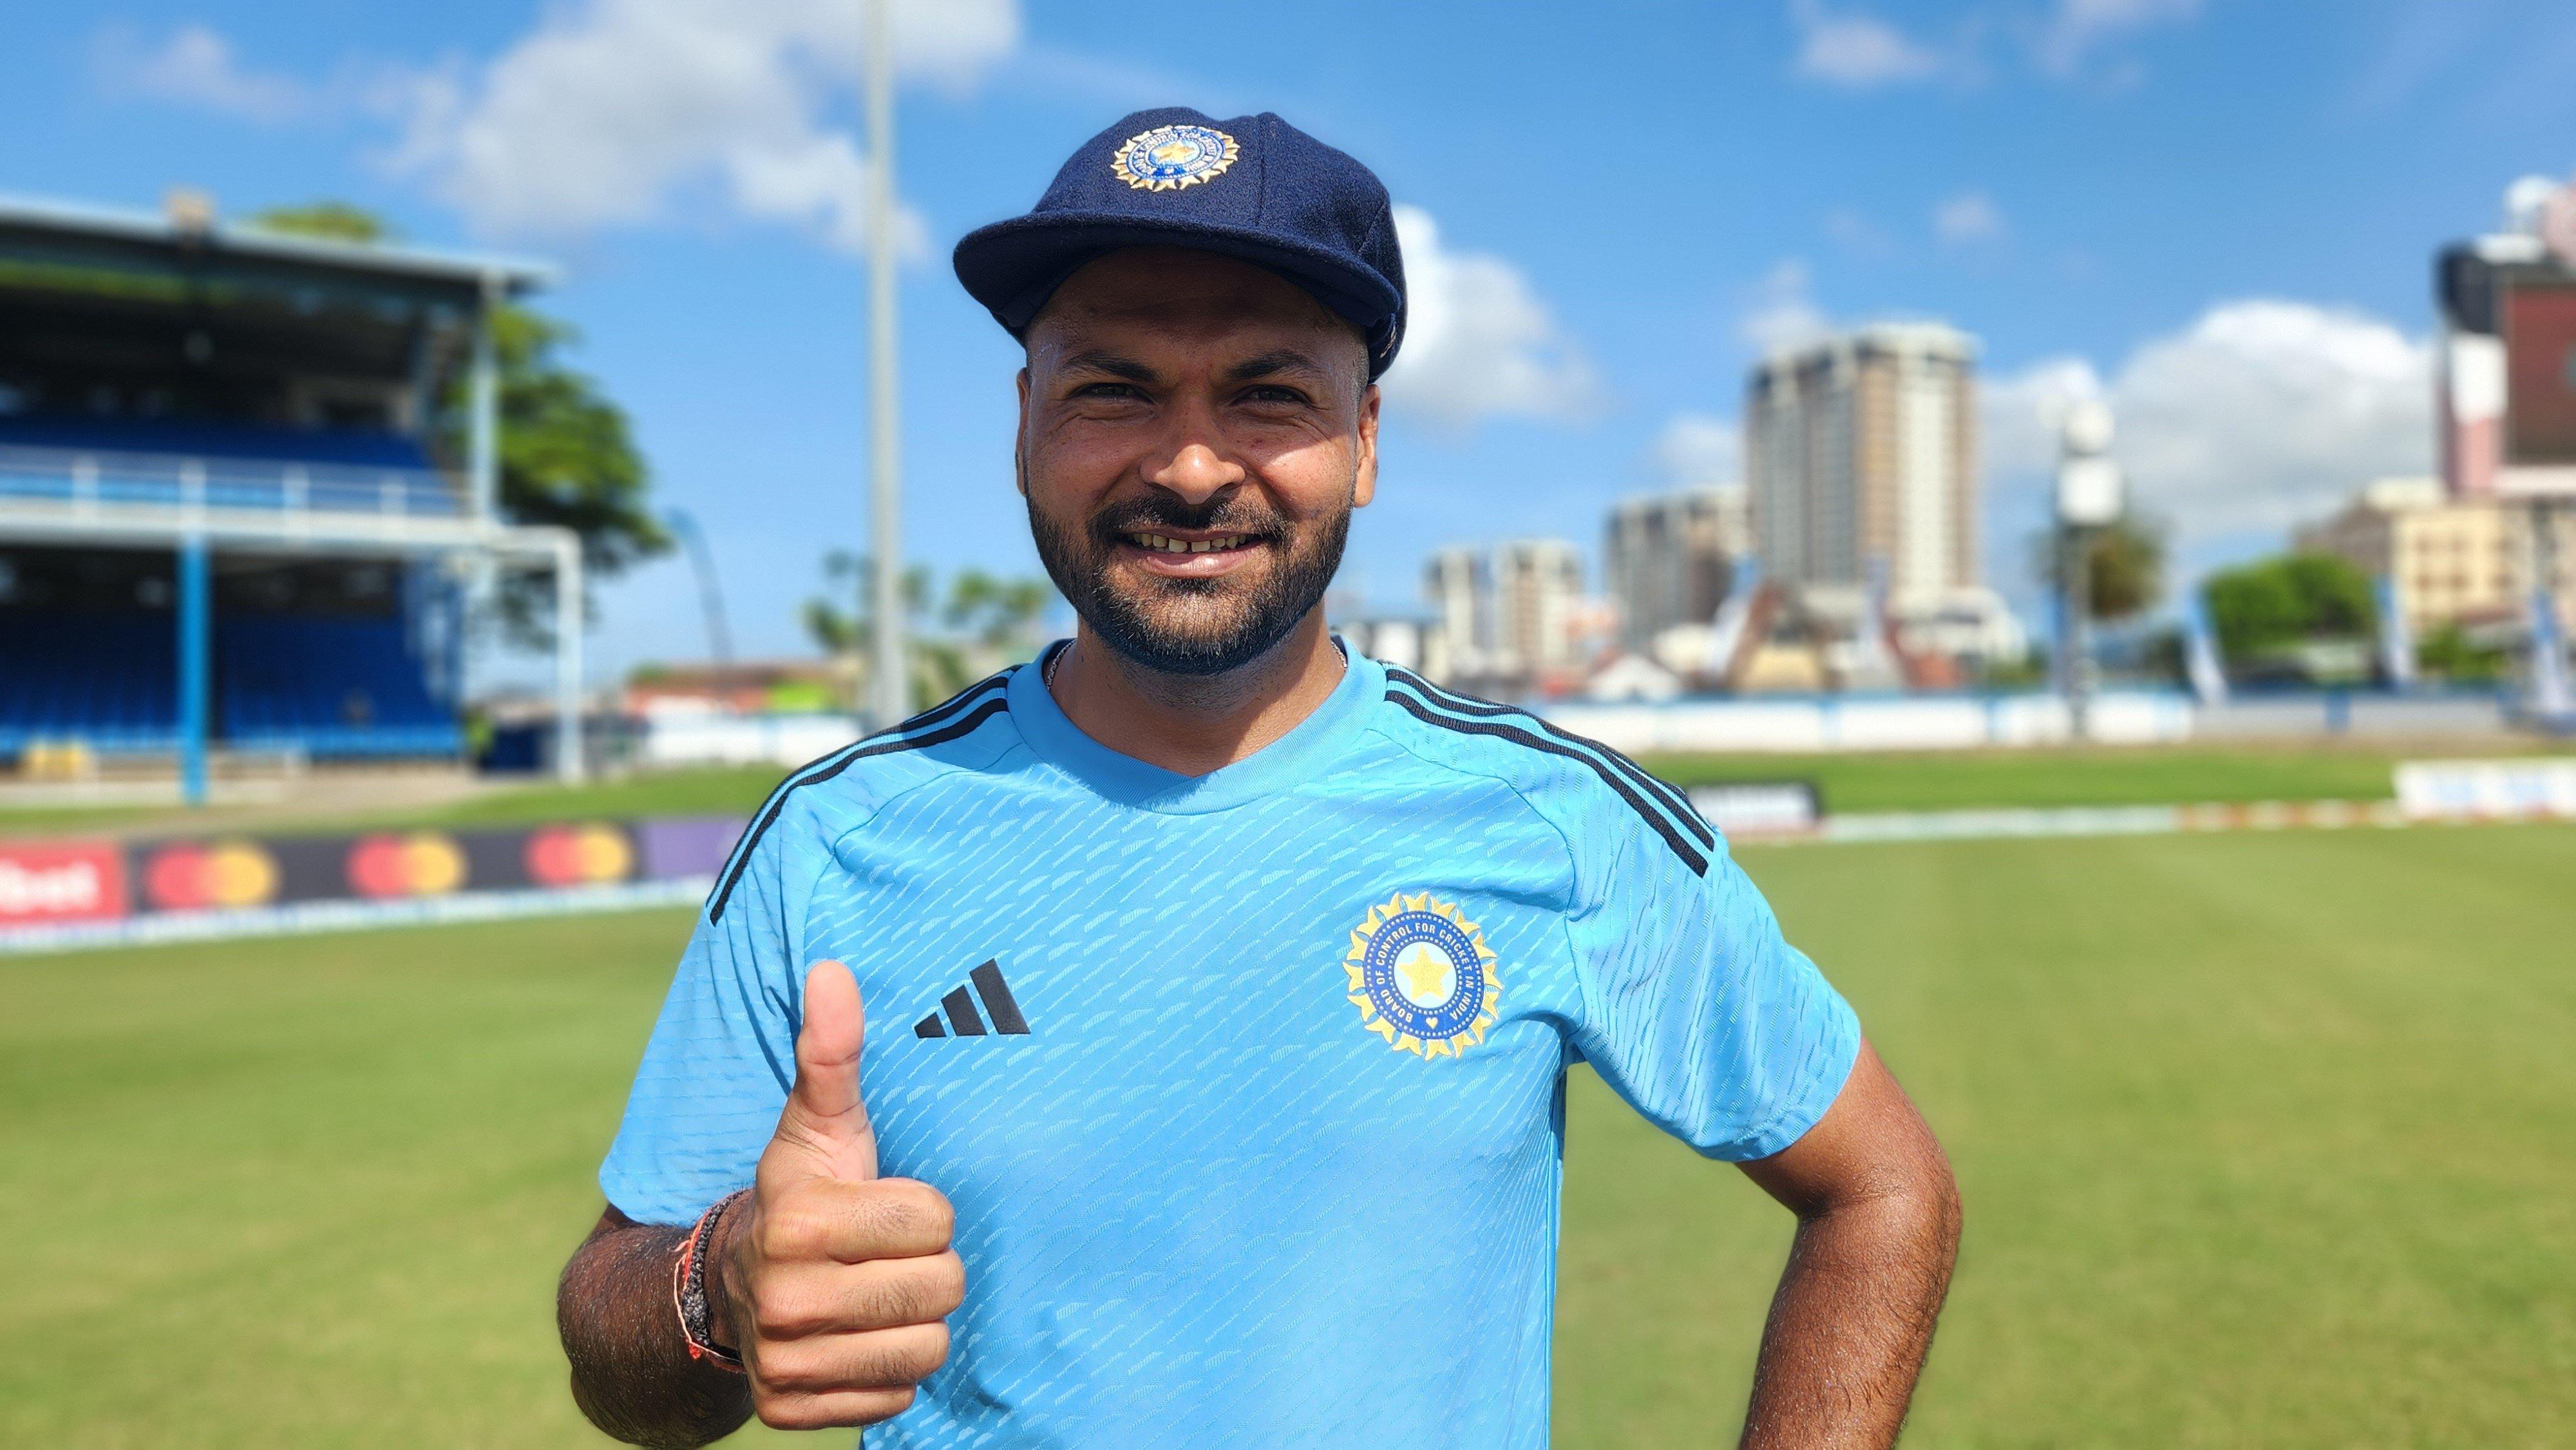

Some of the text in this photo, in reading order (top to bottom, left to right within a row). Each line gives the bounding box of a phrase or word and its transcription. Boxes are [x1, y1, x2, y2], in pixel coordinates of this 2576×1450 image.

[1376, 923, 1474, 1022] BOARD OF CONTROL FOR CRICKET IN INDIA
